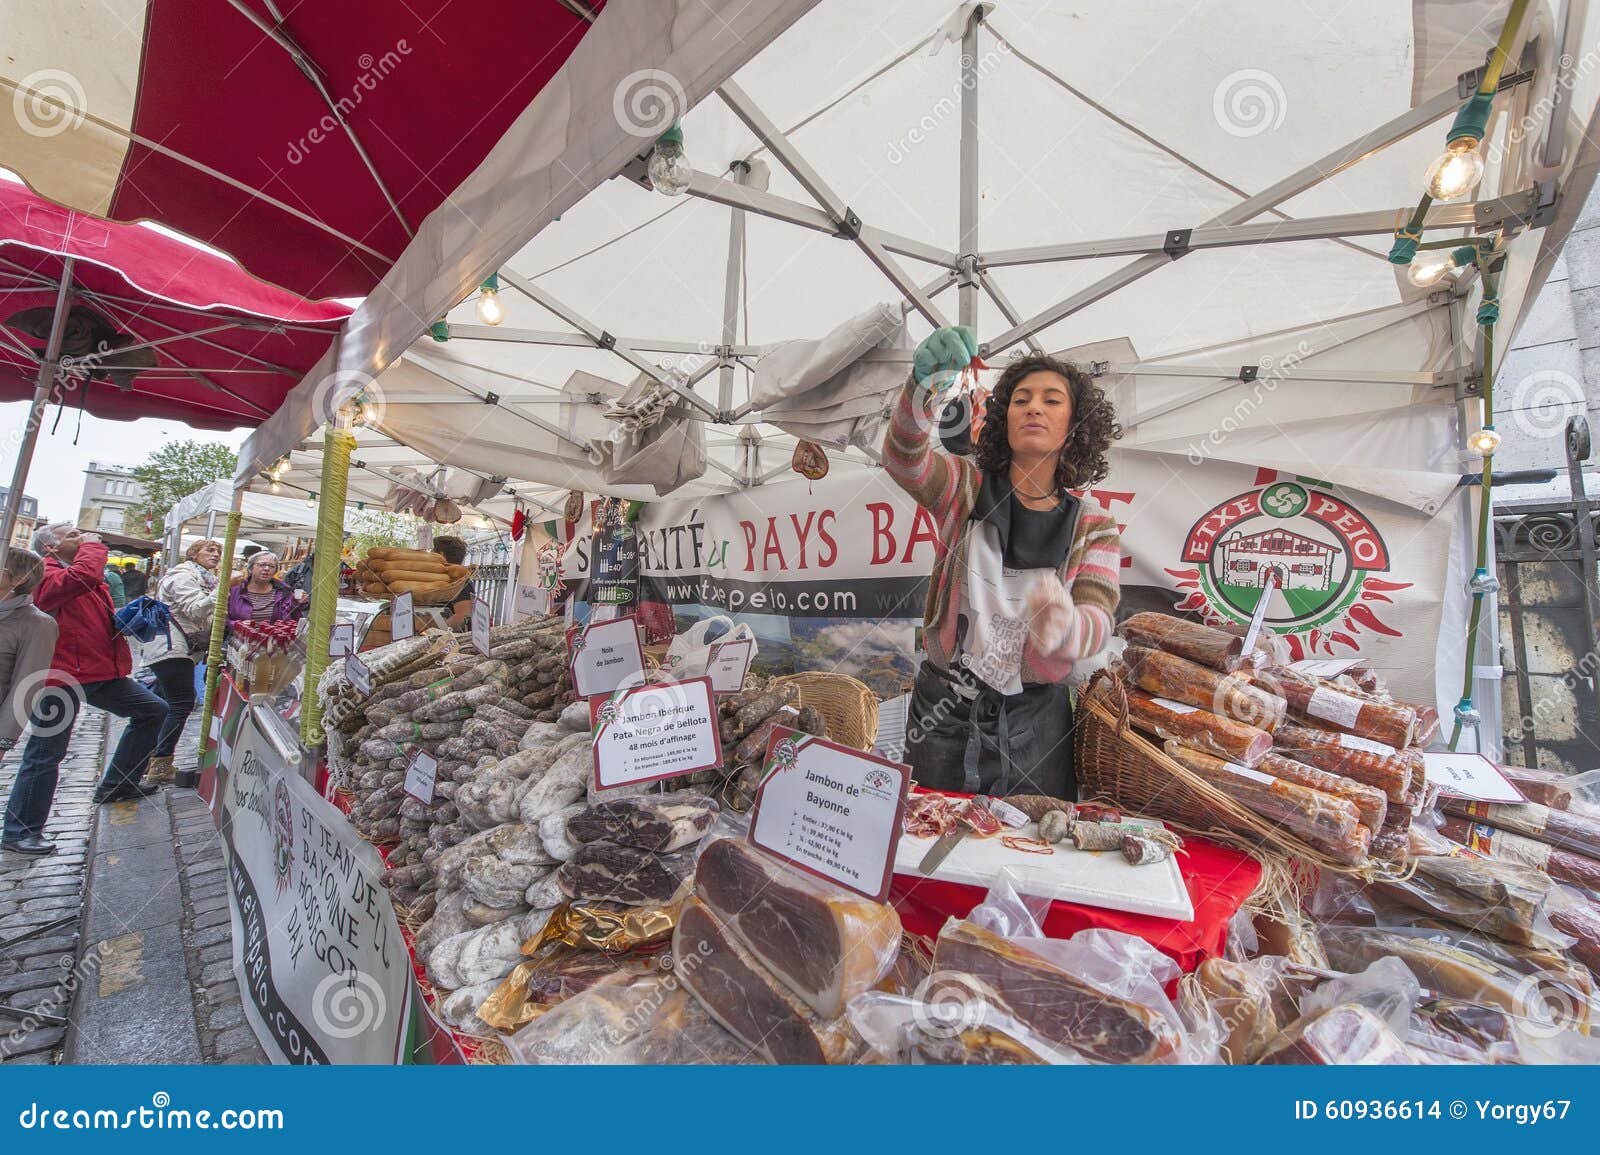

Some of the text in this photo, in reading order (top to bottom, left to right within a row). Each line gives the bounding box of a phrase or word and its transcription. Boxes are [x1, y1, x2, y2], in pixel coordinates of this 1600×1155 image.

[739, 509, 838, 572] PAYS
[1189, 497, 1255, 558] ETXE
[1313, 498, 1379, 562] PEIO
[604, 656, 625, 667] Jambon
[613, 717, 707, 741] Pata Negra de Bellota
[623, 703, 695, 724] Jambon Ibérique
[628, 742, 638, 751] 48
[640, 738, 658, 750] mois
[805, 769, 844, 793] Jambon
[846, 784, 860, 798] de
[806, 791, 850, 817] Bayonne
[301, 807, 378, 920] ST JEAN DE
[303, 838, 360, 950] BAYONNE
[287, 904, 304, 971] DAX
[299, 871, 358, 1000] HOSSEGOR
